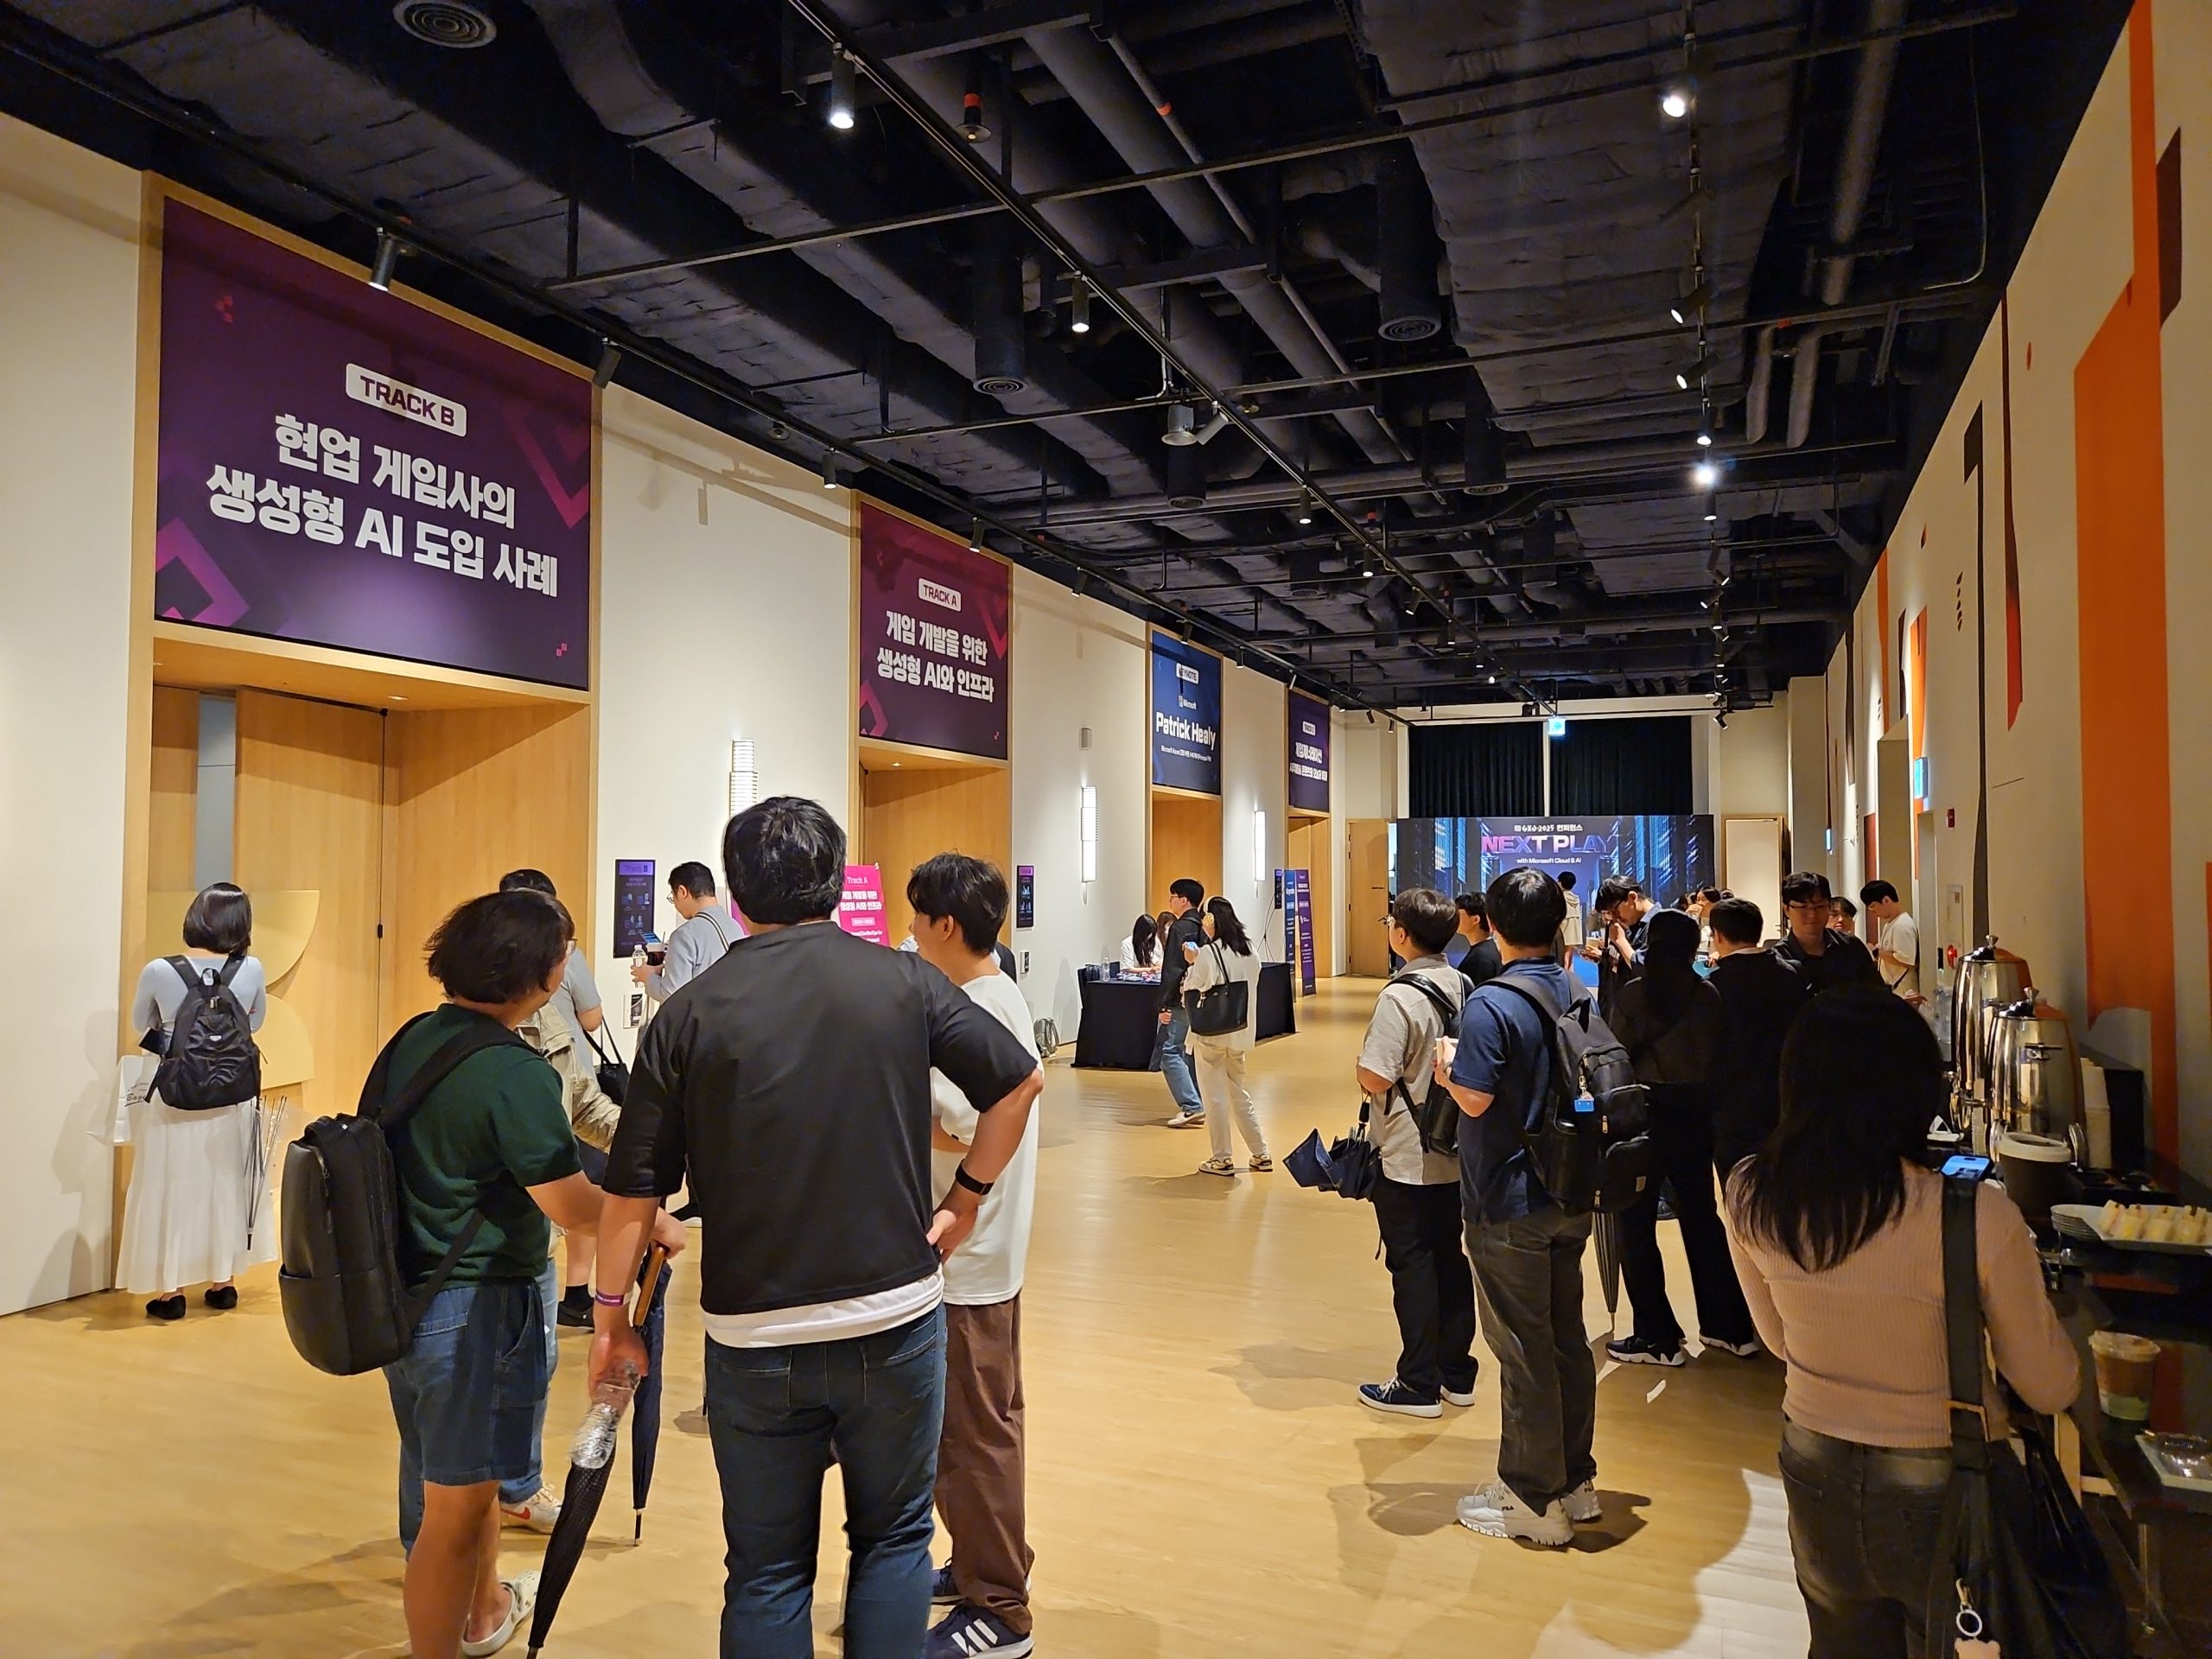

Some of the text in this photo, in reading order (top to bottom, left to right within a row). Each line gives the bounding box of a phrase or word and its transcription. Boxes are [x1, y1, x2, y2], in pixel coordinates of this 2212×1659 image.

[360, 375, 454, 427] TRACK B
[275, 414, 516, 529] 현업 게임사의
[207, 464, 557, 597] 생성형 AI 도입 사례
[923, 584, 957, 607] TRACK A
[887, 610, 988, 666] 게임 개발을 위한
[877, 647, 995, 702] 생성형 AI와 인프라
[1156, 711, 1216, 751] Patrick Healy
[1481, 835, 1611, 854] NEXT PLAY
